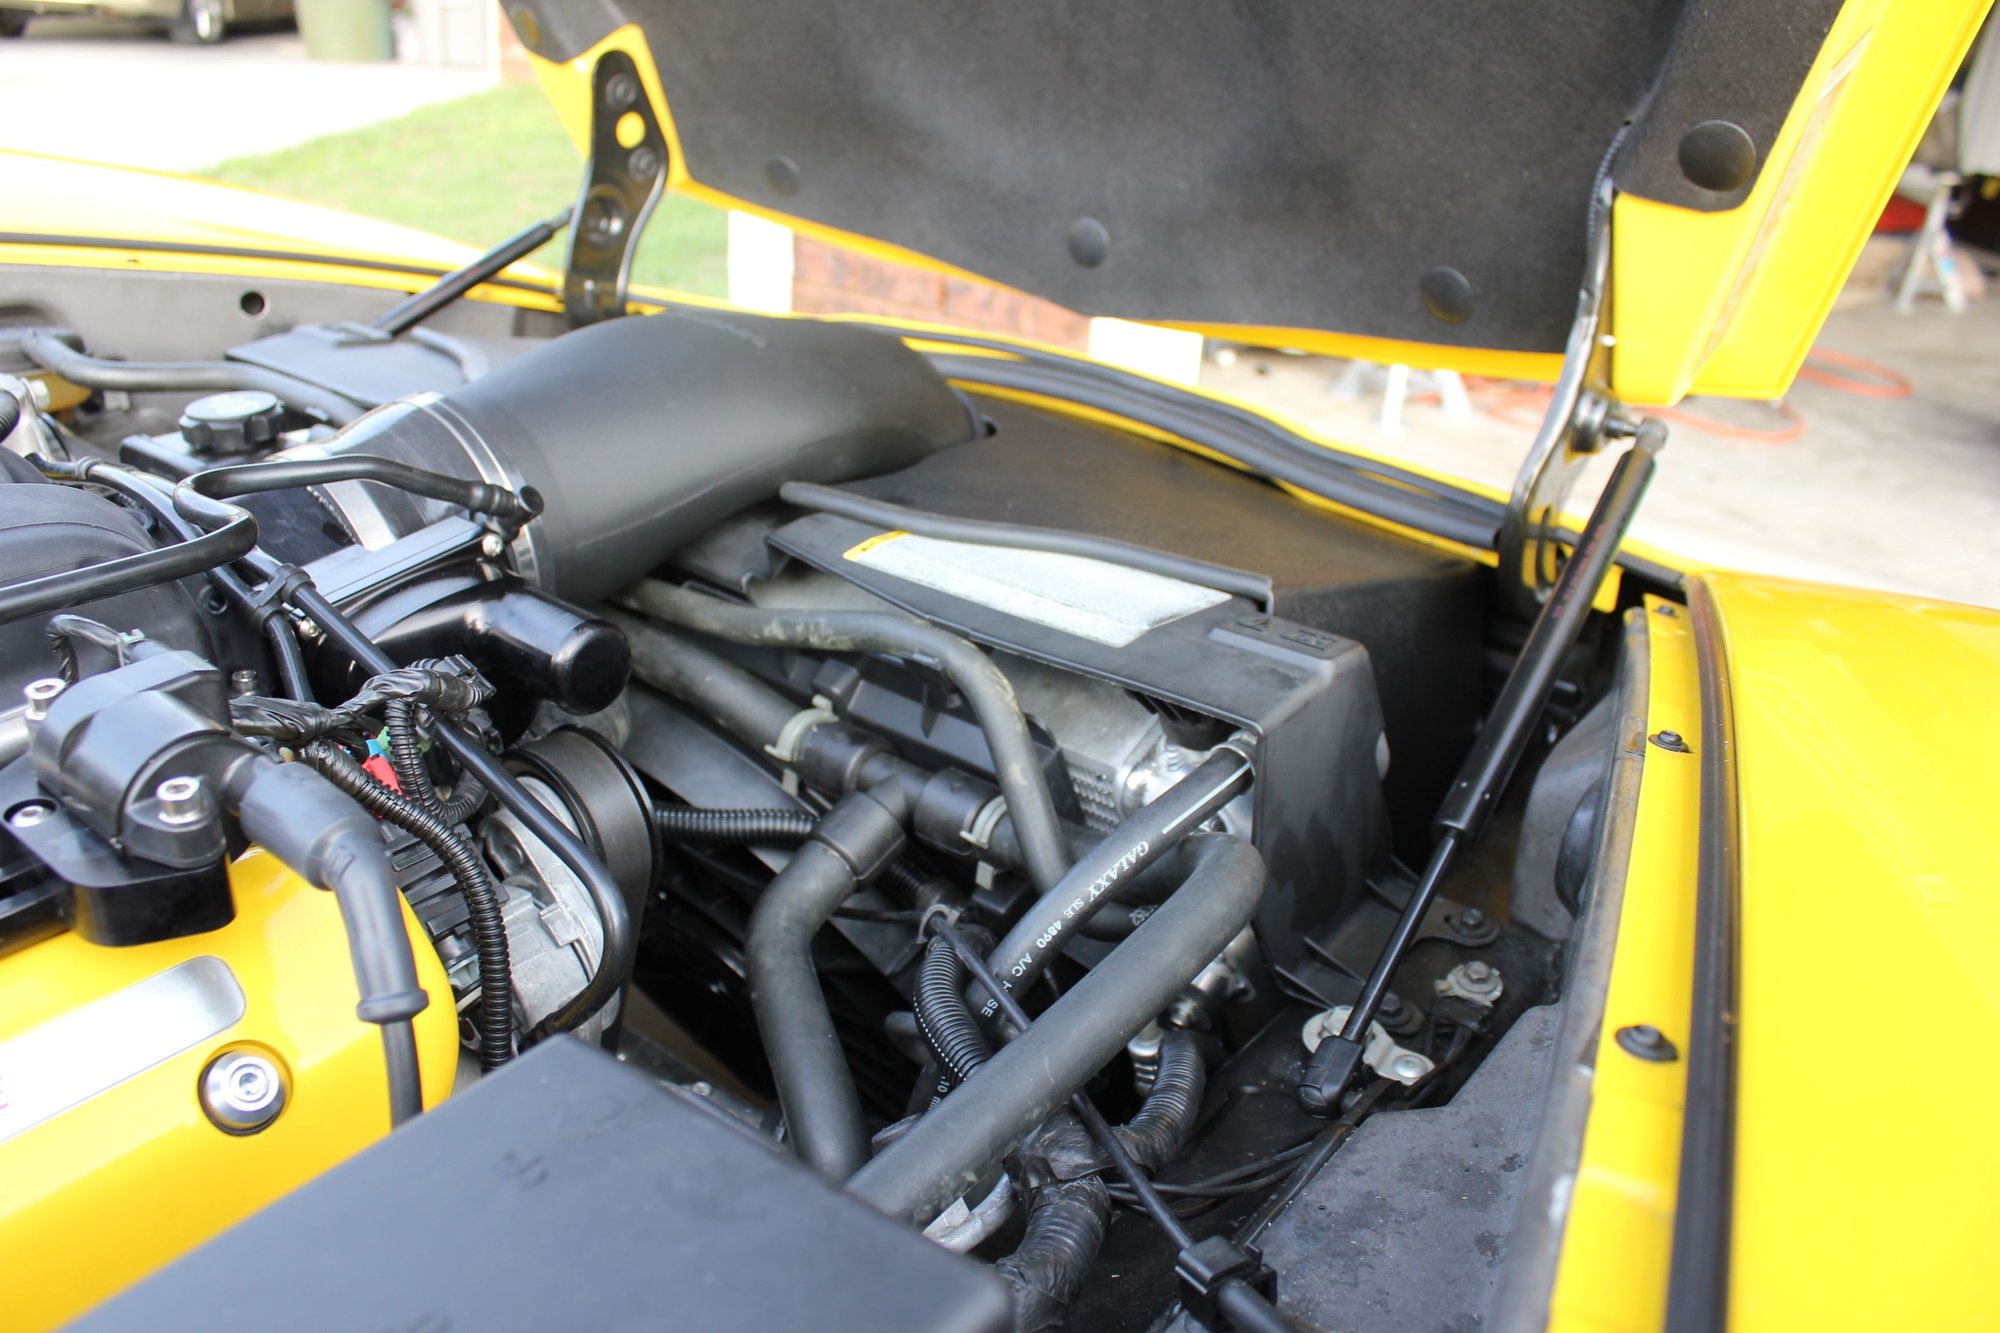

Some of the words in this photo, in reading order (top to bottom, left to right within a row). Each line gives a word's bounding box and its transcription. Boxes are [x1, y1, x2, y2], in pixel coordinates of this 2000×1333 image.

[1087, 840, 1150, 903] GALAXY
[1063, 898, 1085, 919] SLE
[1035, 920, 1063, 949] 4890
[1011, 952, 1033, 977] A/C
[980, 980, 1013, 1018] HSE
